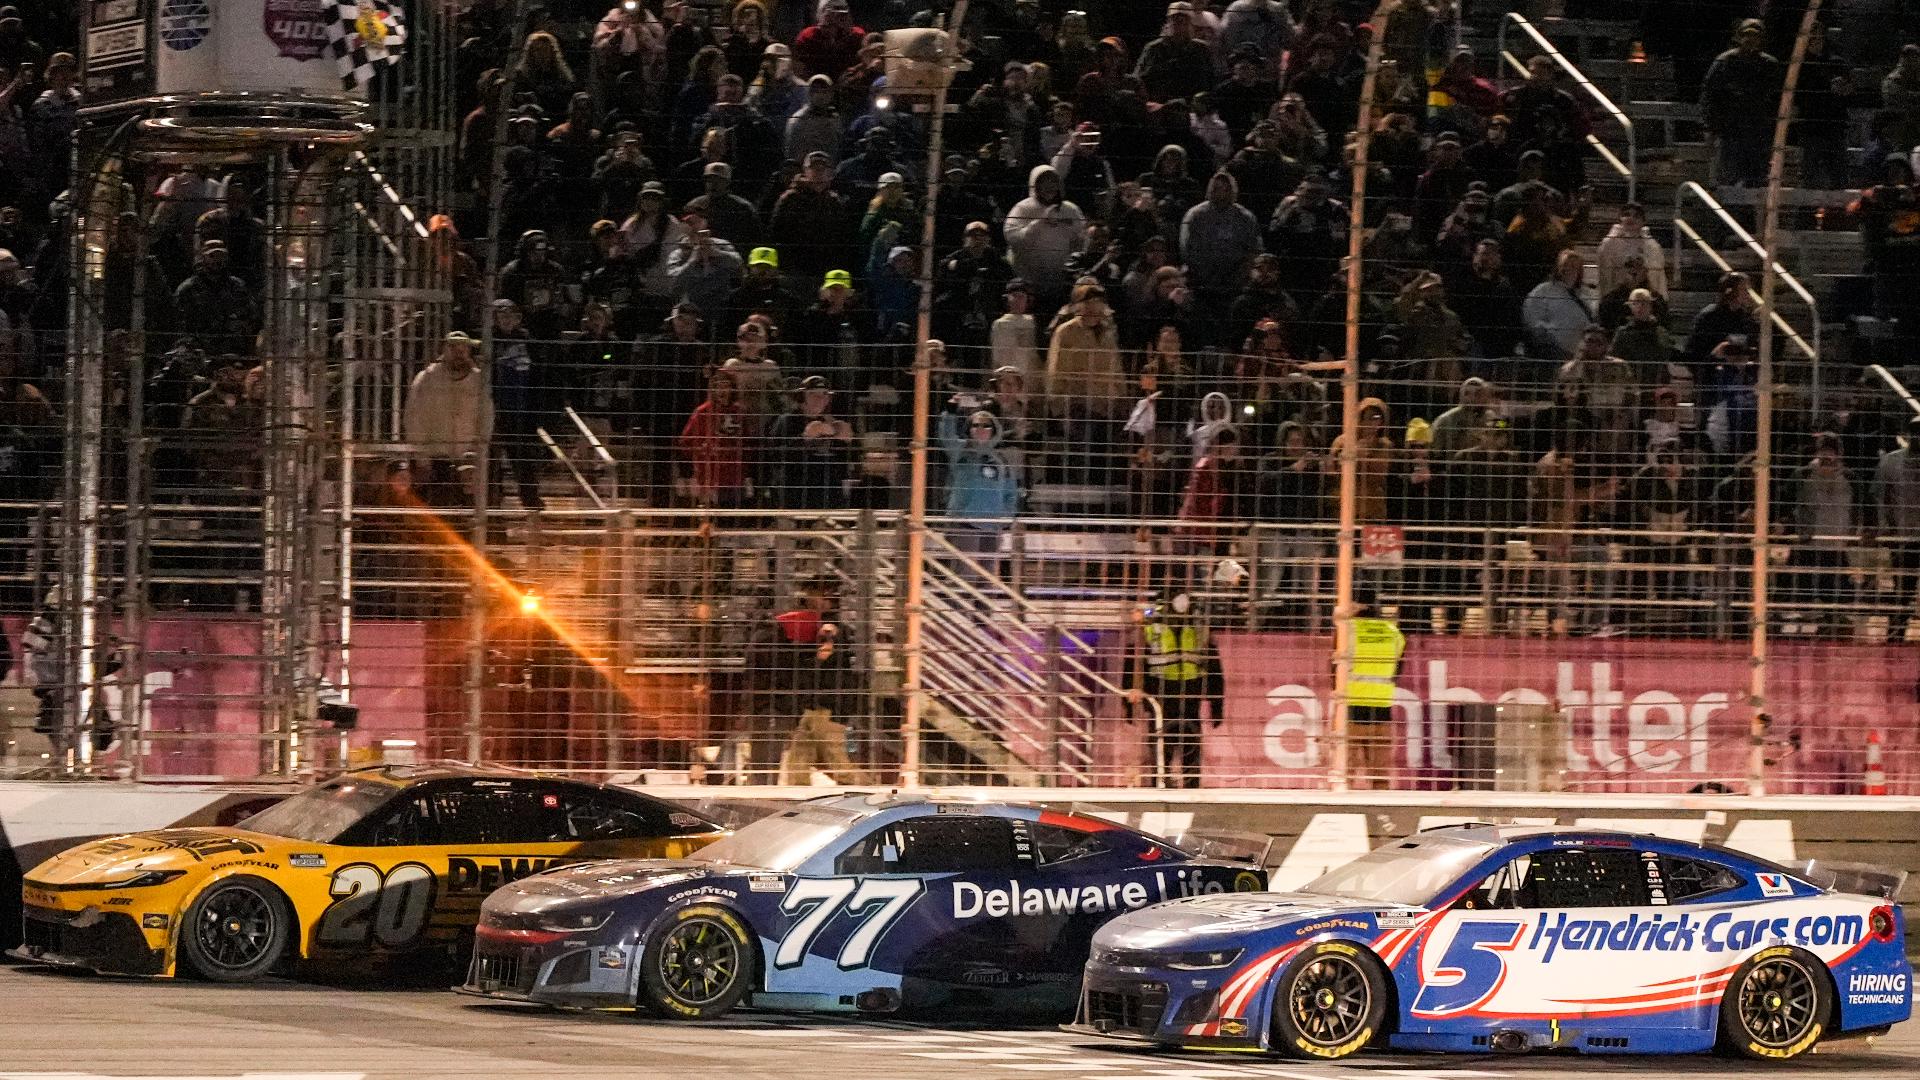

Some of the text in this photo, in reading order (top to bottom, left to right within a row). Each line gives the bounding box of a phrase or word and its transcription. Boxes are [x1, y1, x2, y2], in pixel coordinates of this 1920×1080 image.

[210, 859, 280, 871] GOODYEAR
[318, 861, 440, 946] 20
[667, 885, 738, 903] GOODYEAR
[952, 879, 1148, 919] Delaware
[774, 876, 928, 972] 77
[1295, 919, 1369, 936] GOODYEAR
[1411, 919, 1528, 1017] 5
[1849, 973, 1906, 992] HIRING
[1848, 994, 1904, 1005] TECHNICIANS
